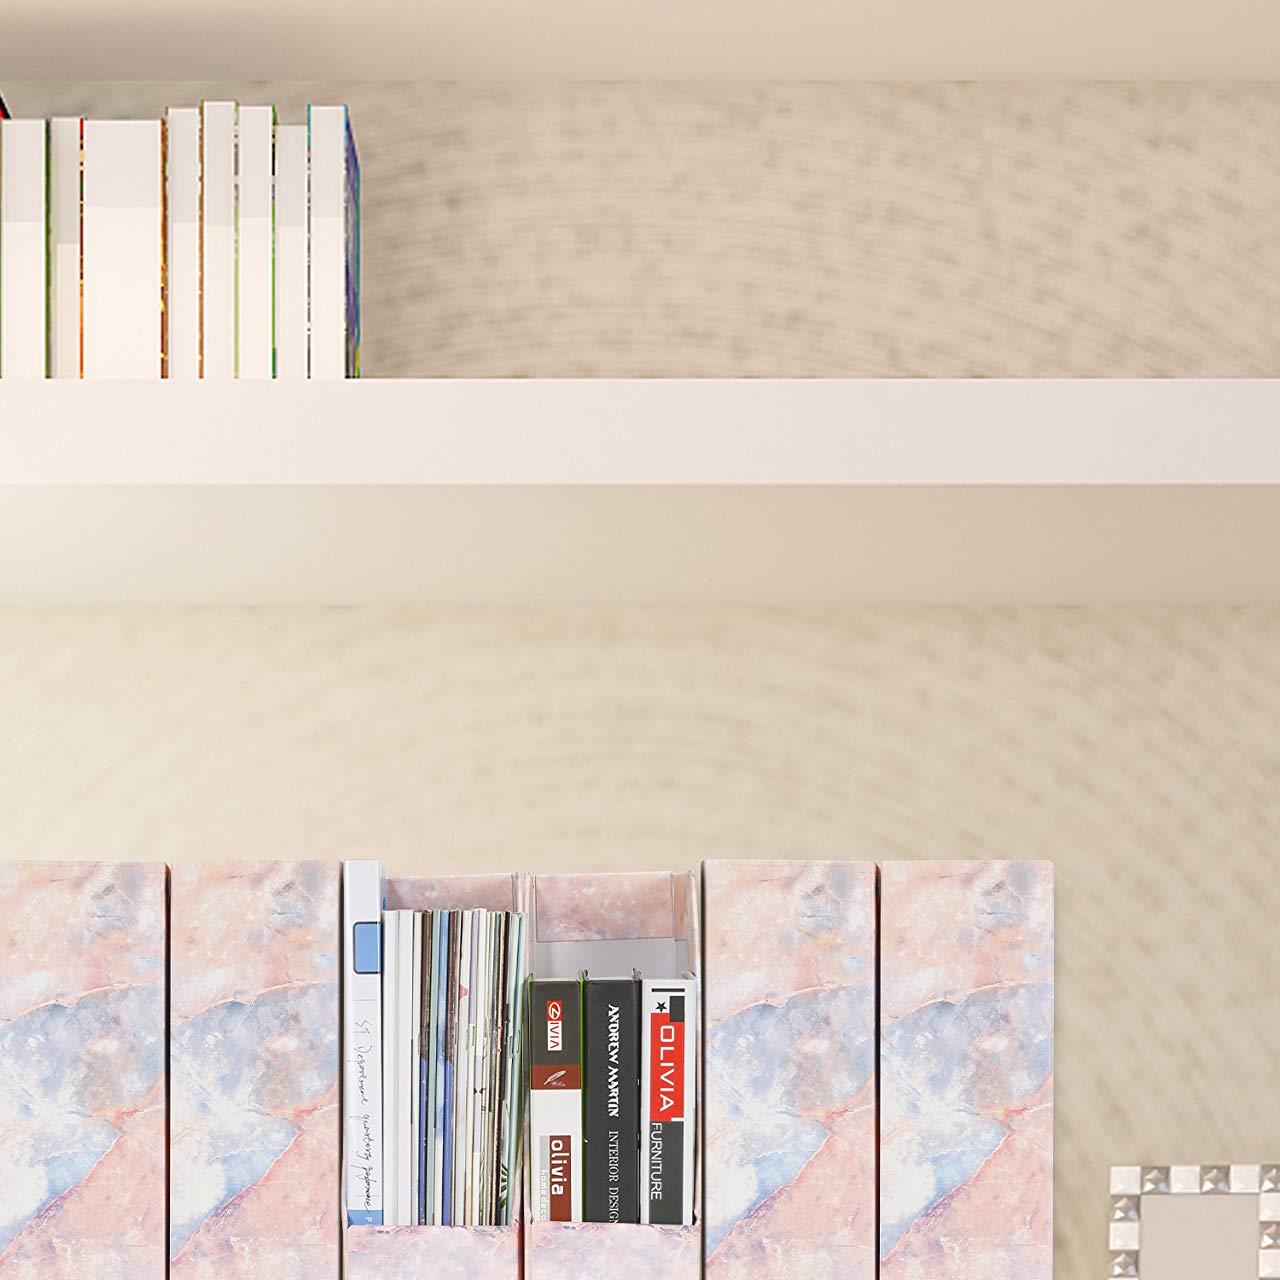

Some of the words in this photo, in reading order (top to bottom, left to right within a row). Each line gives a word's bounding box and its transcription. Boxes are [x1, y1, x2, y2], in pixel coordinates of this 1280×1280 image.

[607, 1004, 620, 1065] ANDREW
[607, 1065, 620, 1117] MARTIN
[660, 1025, 675, 1112] OLIVIA
[551, 1139, 570, 1195] olivia
[608, 1131, 620, 1182] INTERIOR
[650, 1122, 663, 1200] FURNITURE
